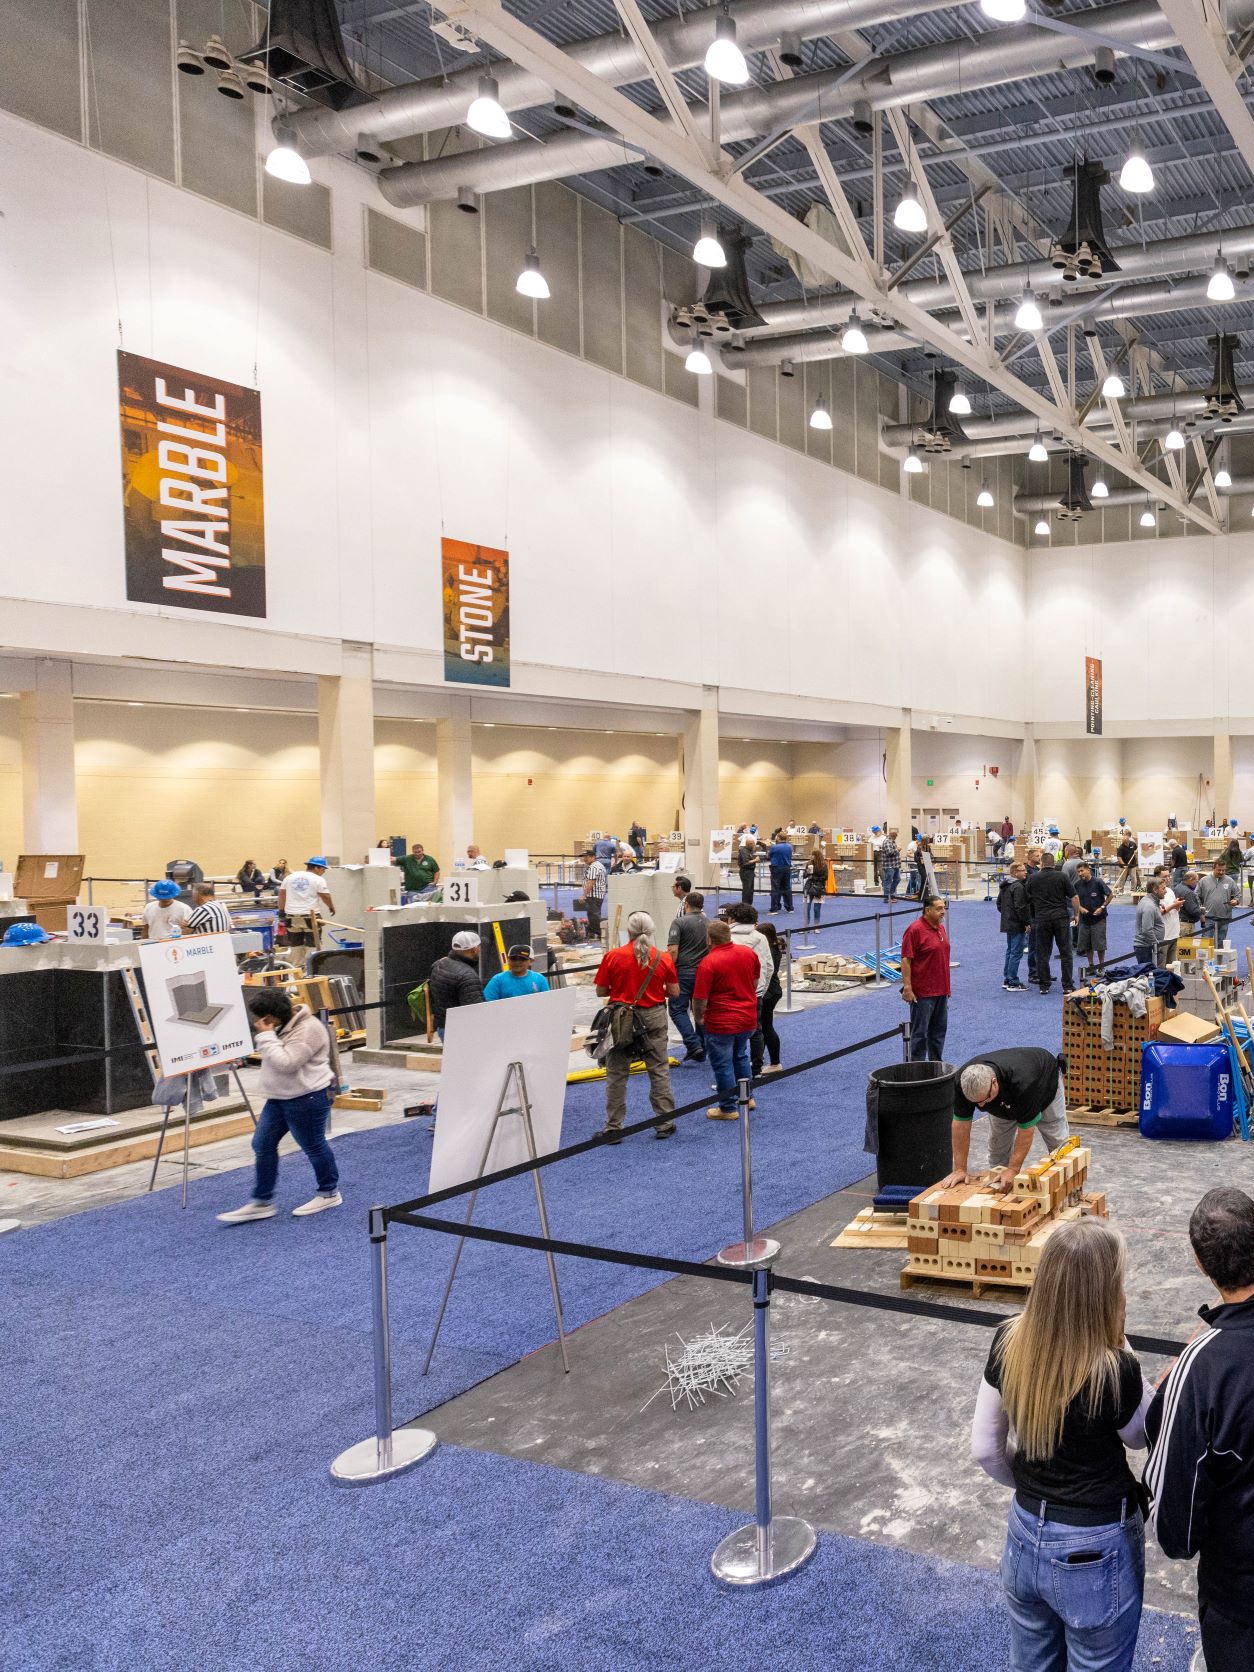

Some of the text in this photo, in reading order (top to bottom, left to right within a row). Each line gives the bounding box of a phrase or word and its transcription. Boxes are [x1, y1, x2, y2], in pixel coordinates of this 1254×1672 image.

[155, 377, 231, 598] MARBLE
[458, 564, 494, 663] STONE
[591, 832, 601, 840] 40
[671, 832, 682, 840] 39
[949, 827, 959, 835] 44
[1210, 829, 1222, 837] 47
[843, 834, 855, 842] 38
[936, 834, 948, 843] 37
[450, 882, 470, 902] 31
[73, 911, 99, 938] 33
[186, 945, 214, 957] MARBLE
[222, 1040, 243, 1051] IMTEF
[1220, 1073, 1230, 1102] Bon
[1143, 1083, 1151, 1111] Bon
